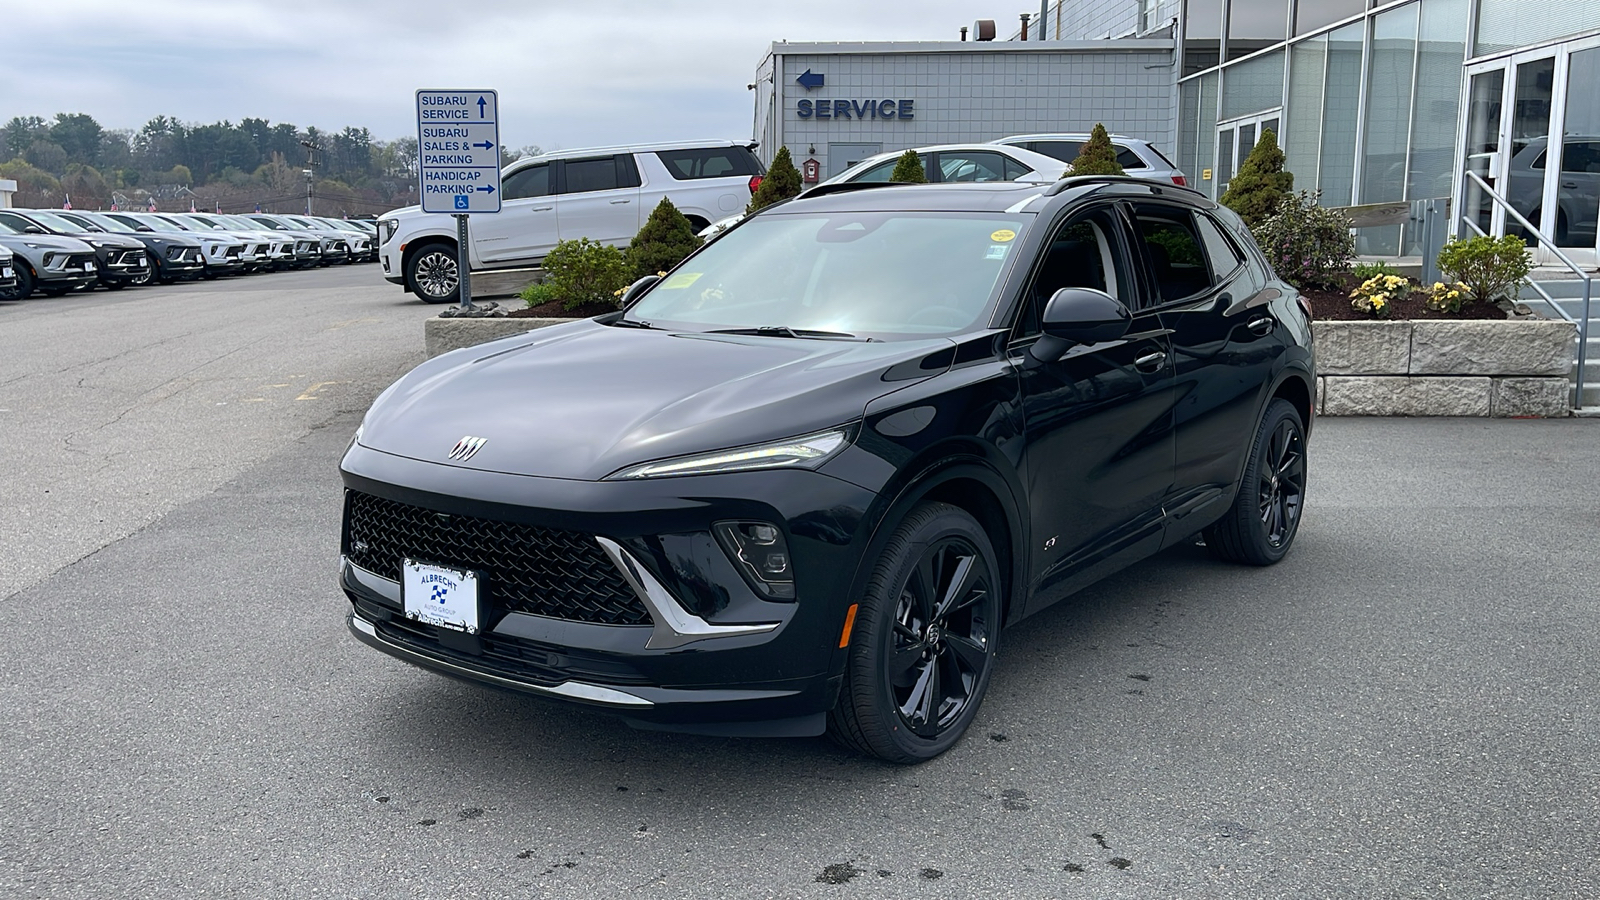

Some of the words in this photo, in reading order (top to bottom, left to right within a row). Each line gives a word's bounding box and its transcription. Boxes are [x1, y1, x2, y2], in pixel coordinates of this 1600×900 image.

[422, 96, 467, 106] SUBARU
[422, 109, 469, 119] SERVICE
[797, 99, 914, 119] SERVICE
[423, 128, 469, 138] SUBARU
[424, 141, 459, 151] SALES
[462, 141, 470, 151] &
[425, 154, 473, 164] PARKING
[425, 171, 481, 181] HANDICAP
[426, 184, 474, 194] PARKING
[420, 574, 457, 591] ALBRECHT
[424, 603, 437, 612] AUTO
[438, 606, 456, 616] GROUP
